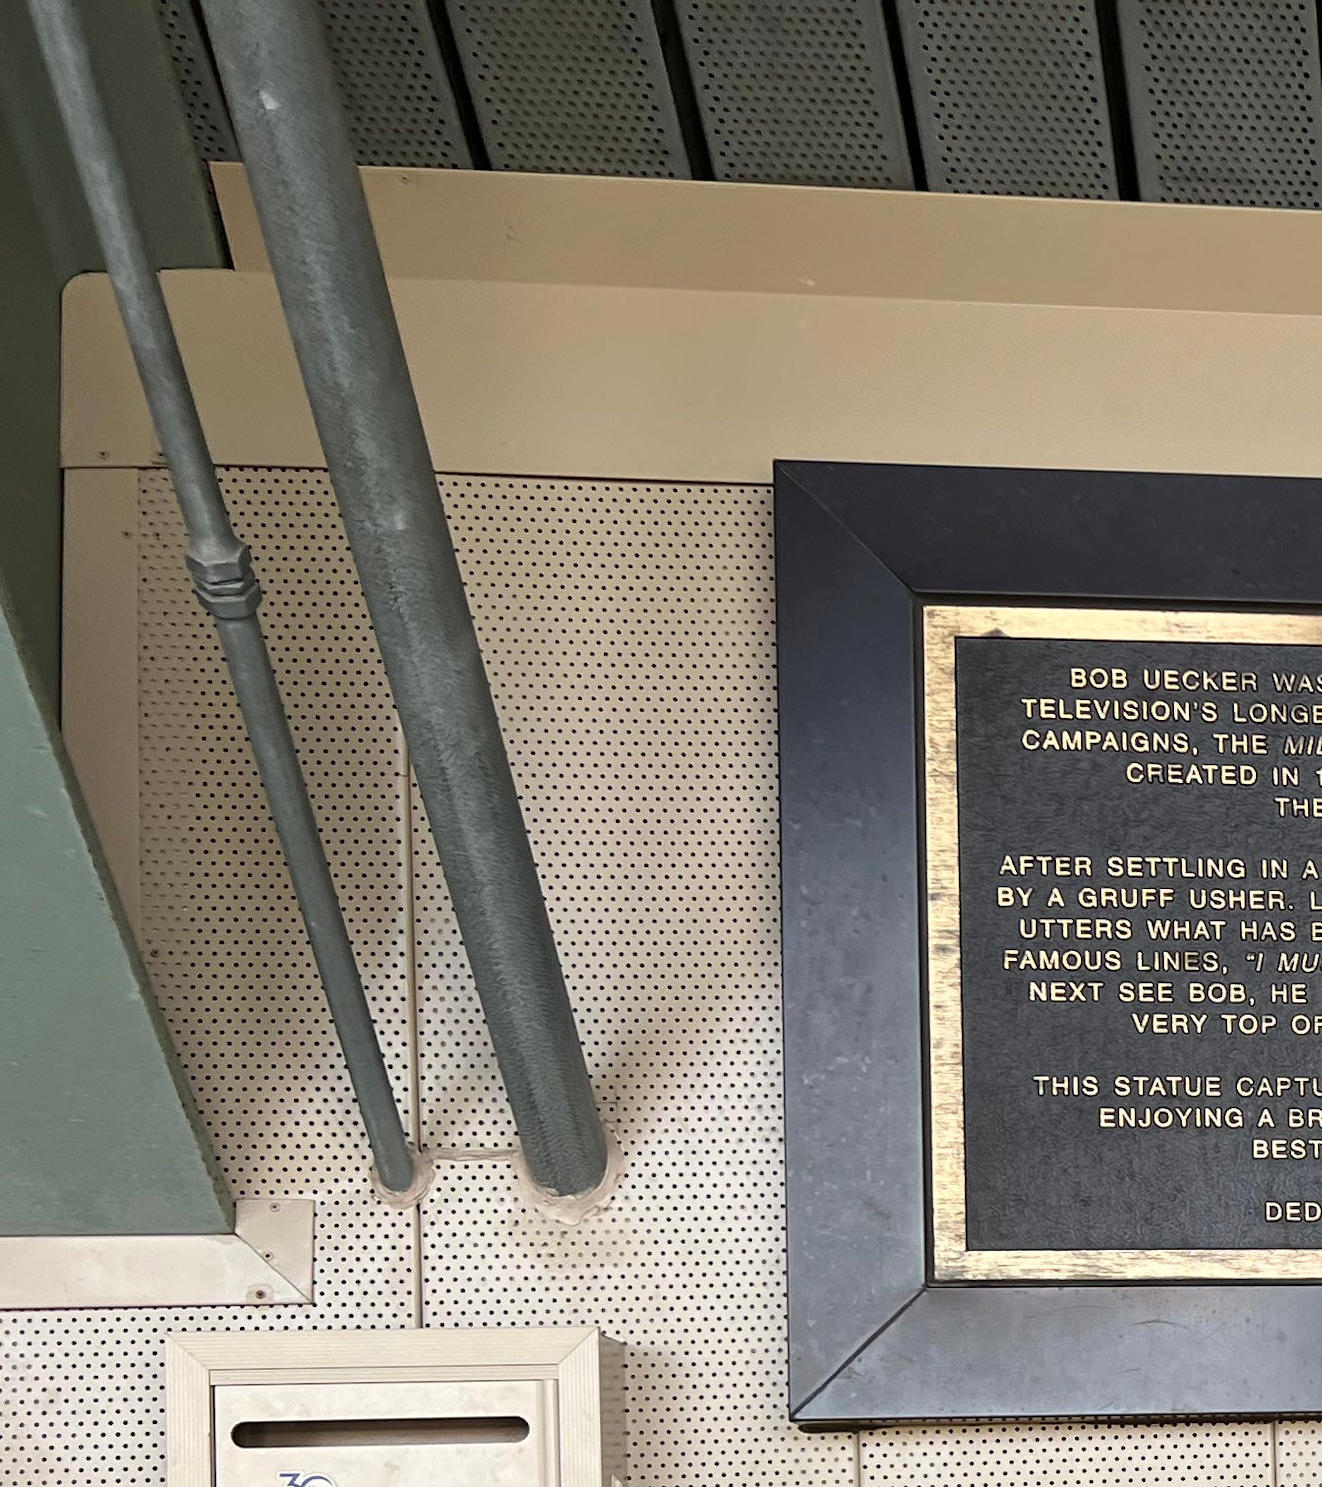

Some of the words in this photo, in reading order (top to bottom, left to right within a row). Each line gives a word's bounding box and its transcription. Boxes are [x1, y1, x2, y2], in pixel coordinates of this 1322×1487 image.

[1070, 667, 1128, 689] BOB
[1143, 668, 1257, 691] UECKER
[1020, 697, 1218, 722] TELEVISION'S
[1021, 728, 1198, 756] CAMPAIGNS,
[1212, 732, 1268, 754] THE
[1125, 761, 1257, 785] CREATED
[1272, 766, 1299, 786] IN
[999, 854, 1092, 876] AFTER
[1106, 856, 1245, 878] SETTLING
[1261, 858, 1288, 879] IN
[1302, 859, 1319, 879] A
[997, 886, 1033, 907] BY
[1046, 886, 1065, 907] A
[1077, 886, 1174, 908] GRUFF
[1189, 888, 1293, 910] USHER.
[1019, 918, 1132, 939] UTTERS
[1146, 919, 1226, 940] WHAT
[1240, 920, 1296, 942] HAS
[1003, 949, 1121, 971] FAMOUS
[1136, 950, 1228, 975] LINES,
[1028, 981, 1104, 1002] NEXT
[1118, 981, 1173, 1002] SEE
[1188, 982, 1255, 1006] BOB,
[1270, 983, 1307, 1003] HE
[1131, 1012, 1207, 1034] VERY
[1220, 1013, 1277, 1034] TOP
[1032, 1075, 1099, 1096] THIS
[1114, 1075, 1221, 1097] STATUE
[1099, 1107, 1243, 1128] ENJOYING
[1257, 1108, 1275, 1128] A
